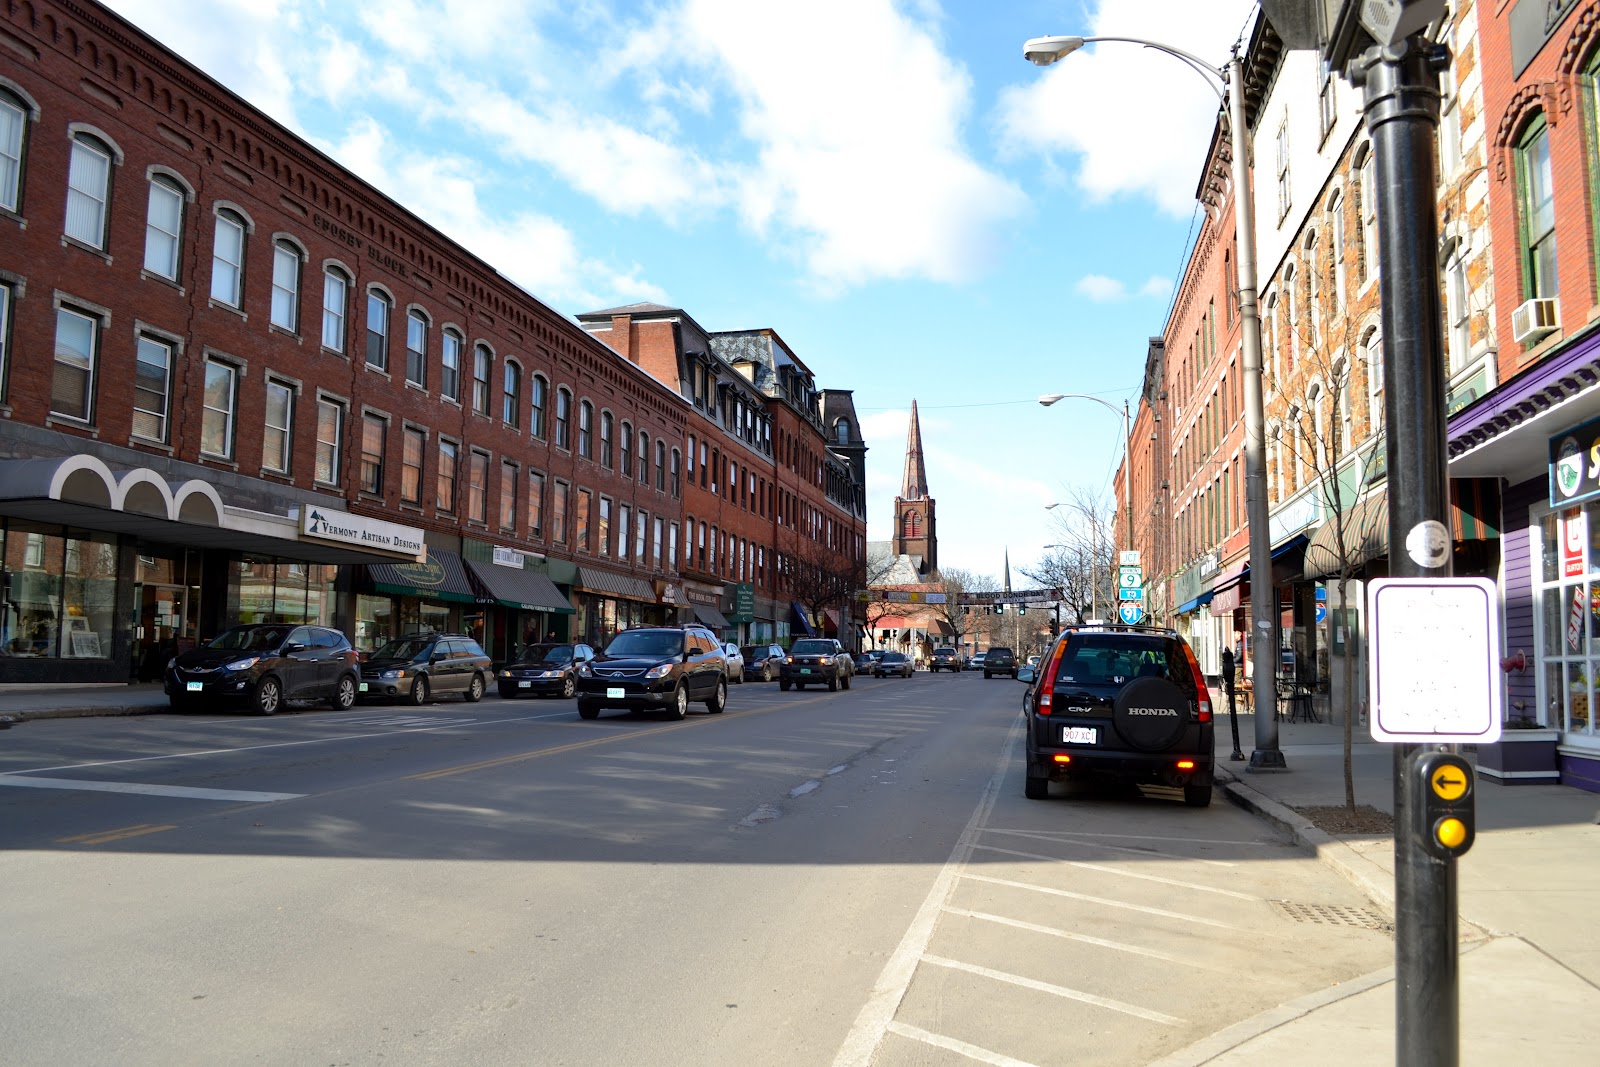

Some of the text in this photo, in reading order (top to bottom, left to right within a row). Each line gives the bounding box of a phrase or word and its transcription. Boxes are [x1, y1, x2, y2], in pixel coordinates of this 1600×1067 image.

[323, 522, 420, 551] VERMONT ARTISAN DESIGNS
[1124, 553, 1137, 562] JCT
[1566, 561, 1582, 573] BURTON
[1127, 575, 1135, 586] 9
[1123, 608, 1137, 620] 91
[1128, 707, 1178, 716] HONDA
[1064, 730, 1079, 740] 907
